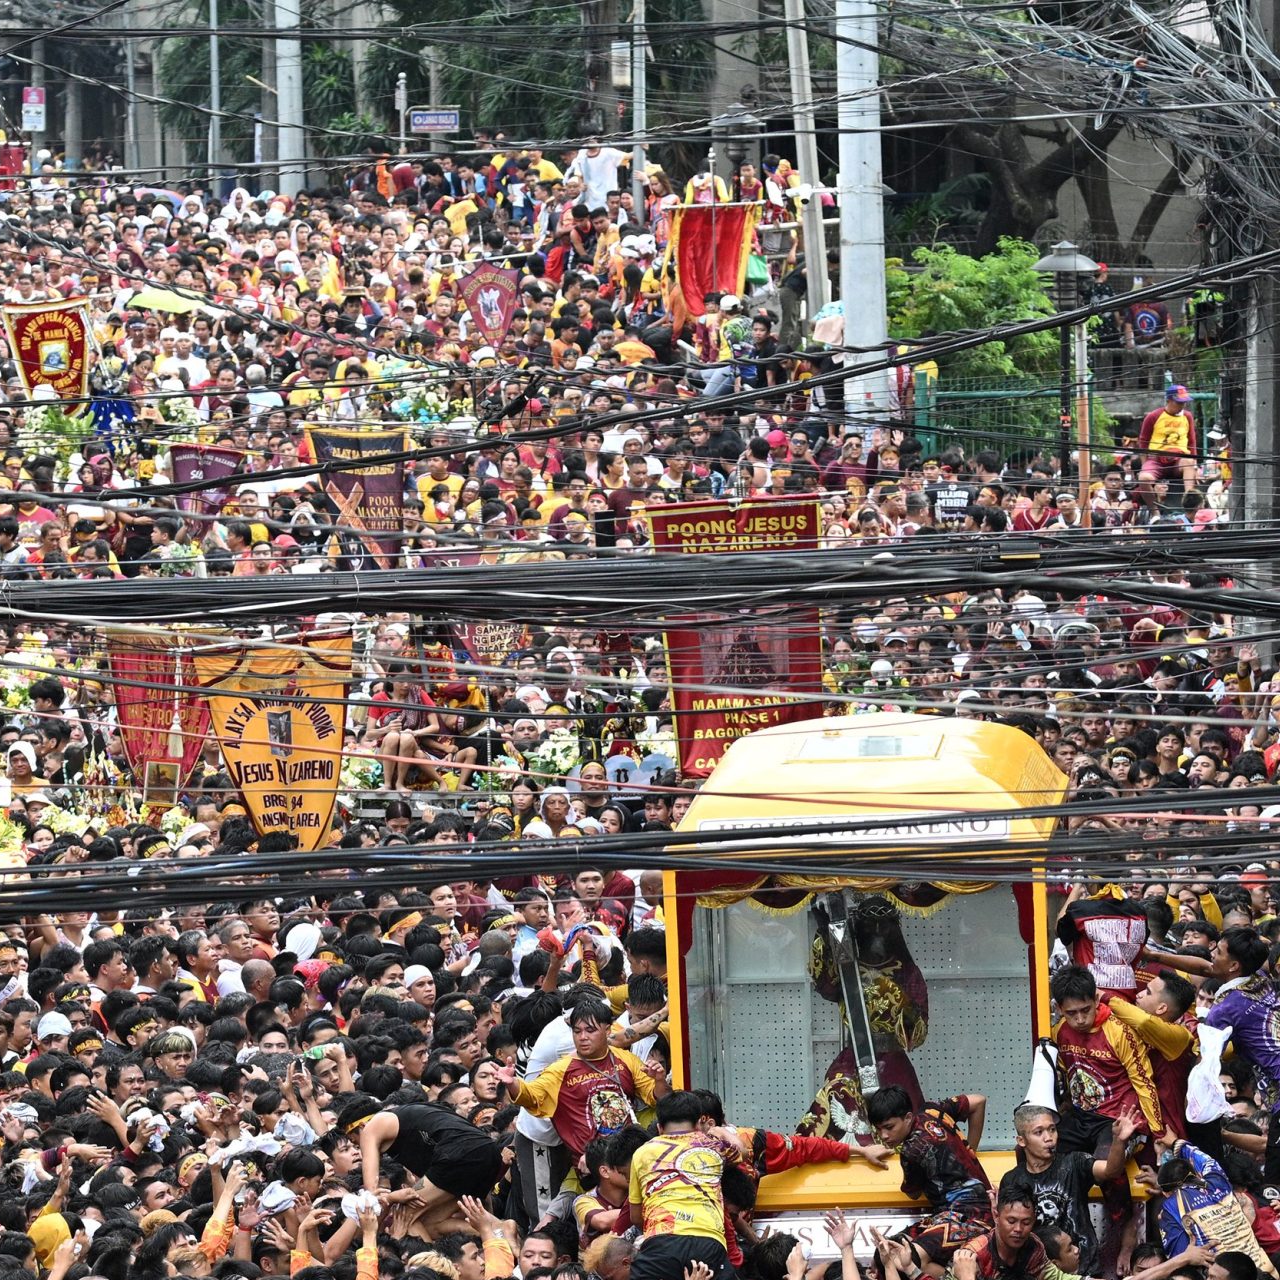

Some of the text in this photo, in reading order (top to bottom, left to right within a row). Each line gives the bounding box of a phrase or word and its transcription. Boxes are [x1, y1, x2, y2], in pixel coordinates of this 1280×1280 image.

[369, 496, 395, 507] POOK
[366, 520, 400, 530] CHAPTER
[666, 515, 808, 539] POONG JESUS
[682, 531, 798, 553] NAZARENO
[239, 702, 256, 722] SA
[305, 702, 336, 740] POONG
[725, 710, 780, 724] PHASE 1
[694, 728, 752, 739] BAGONG
[234, 760, 274, 786] JESUS
[296, 812, 320, 828] AREA
[1089, 1049, 1112, 1058] 2026
